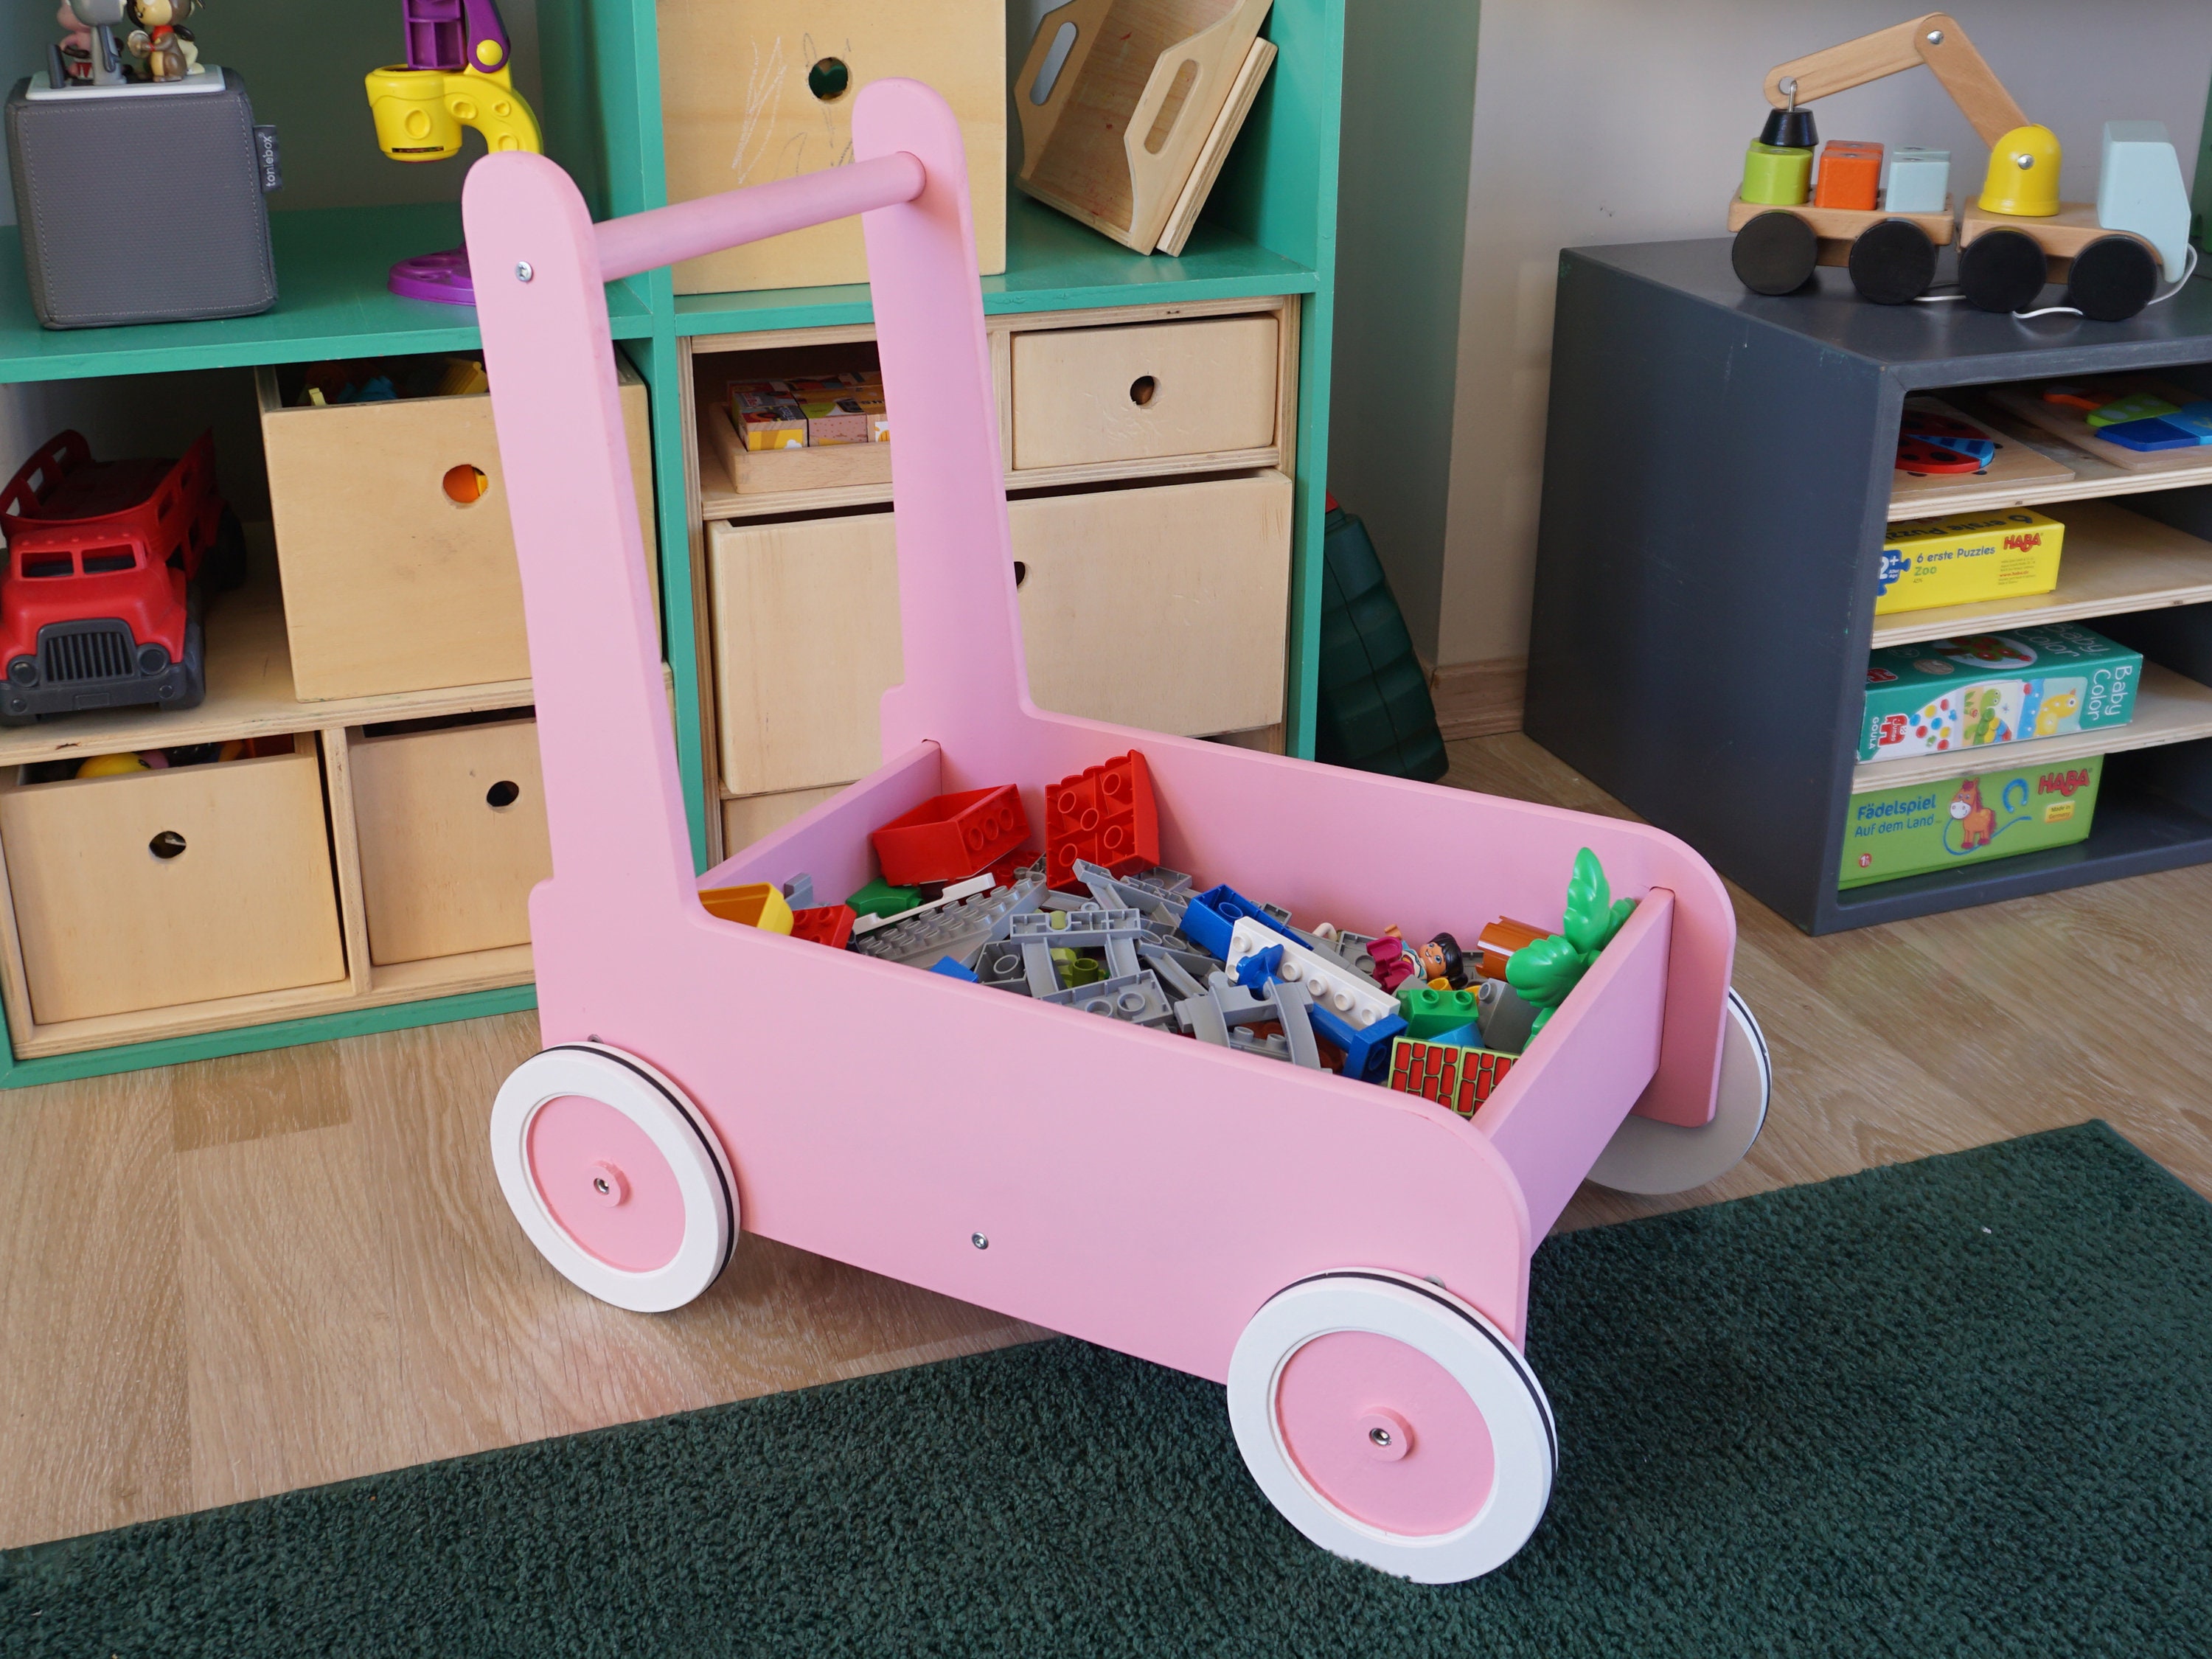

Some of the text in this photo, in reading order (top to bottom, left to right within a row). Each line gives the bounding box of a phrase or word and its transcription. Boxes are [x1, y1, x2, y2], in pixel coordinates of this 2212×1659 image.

[1885, 527, 1949, 540] Puzzl
[1947, 519, 2007, 531] erste
[1916, 546, 1996, 563] 6 erste Puzzles
[2003, 532, 2042, 553] HABA
[1914, 566, 1937, 577] Zoo
[2014, 628, 2080, 658] Color
[2087, 669, 2112, 720] Color
[2104, 665, 2133, 716] Baby
[1868, 716, 1880, 750] GOULA
[2038, 768, 2090, 797] HABA
[1857, 793, 1936, 821] Fädelspiel
[1854, 813, 1935, 838] Auf dem Land
